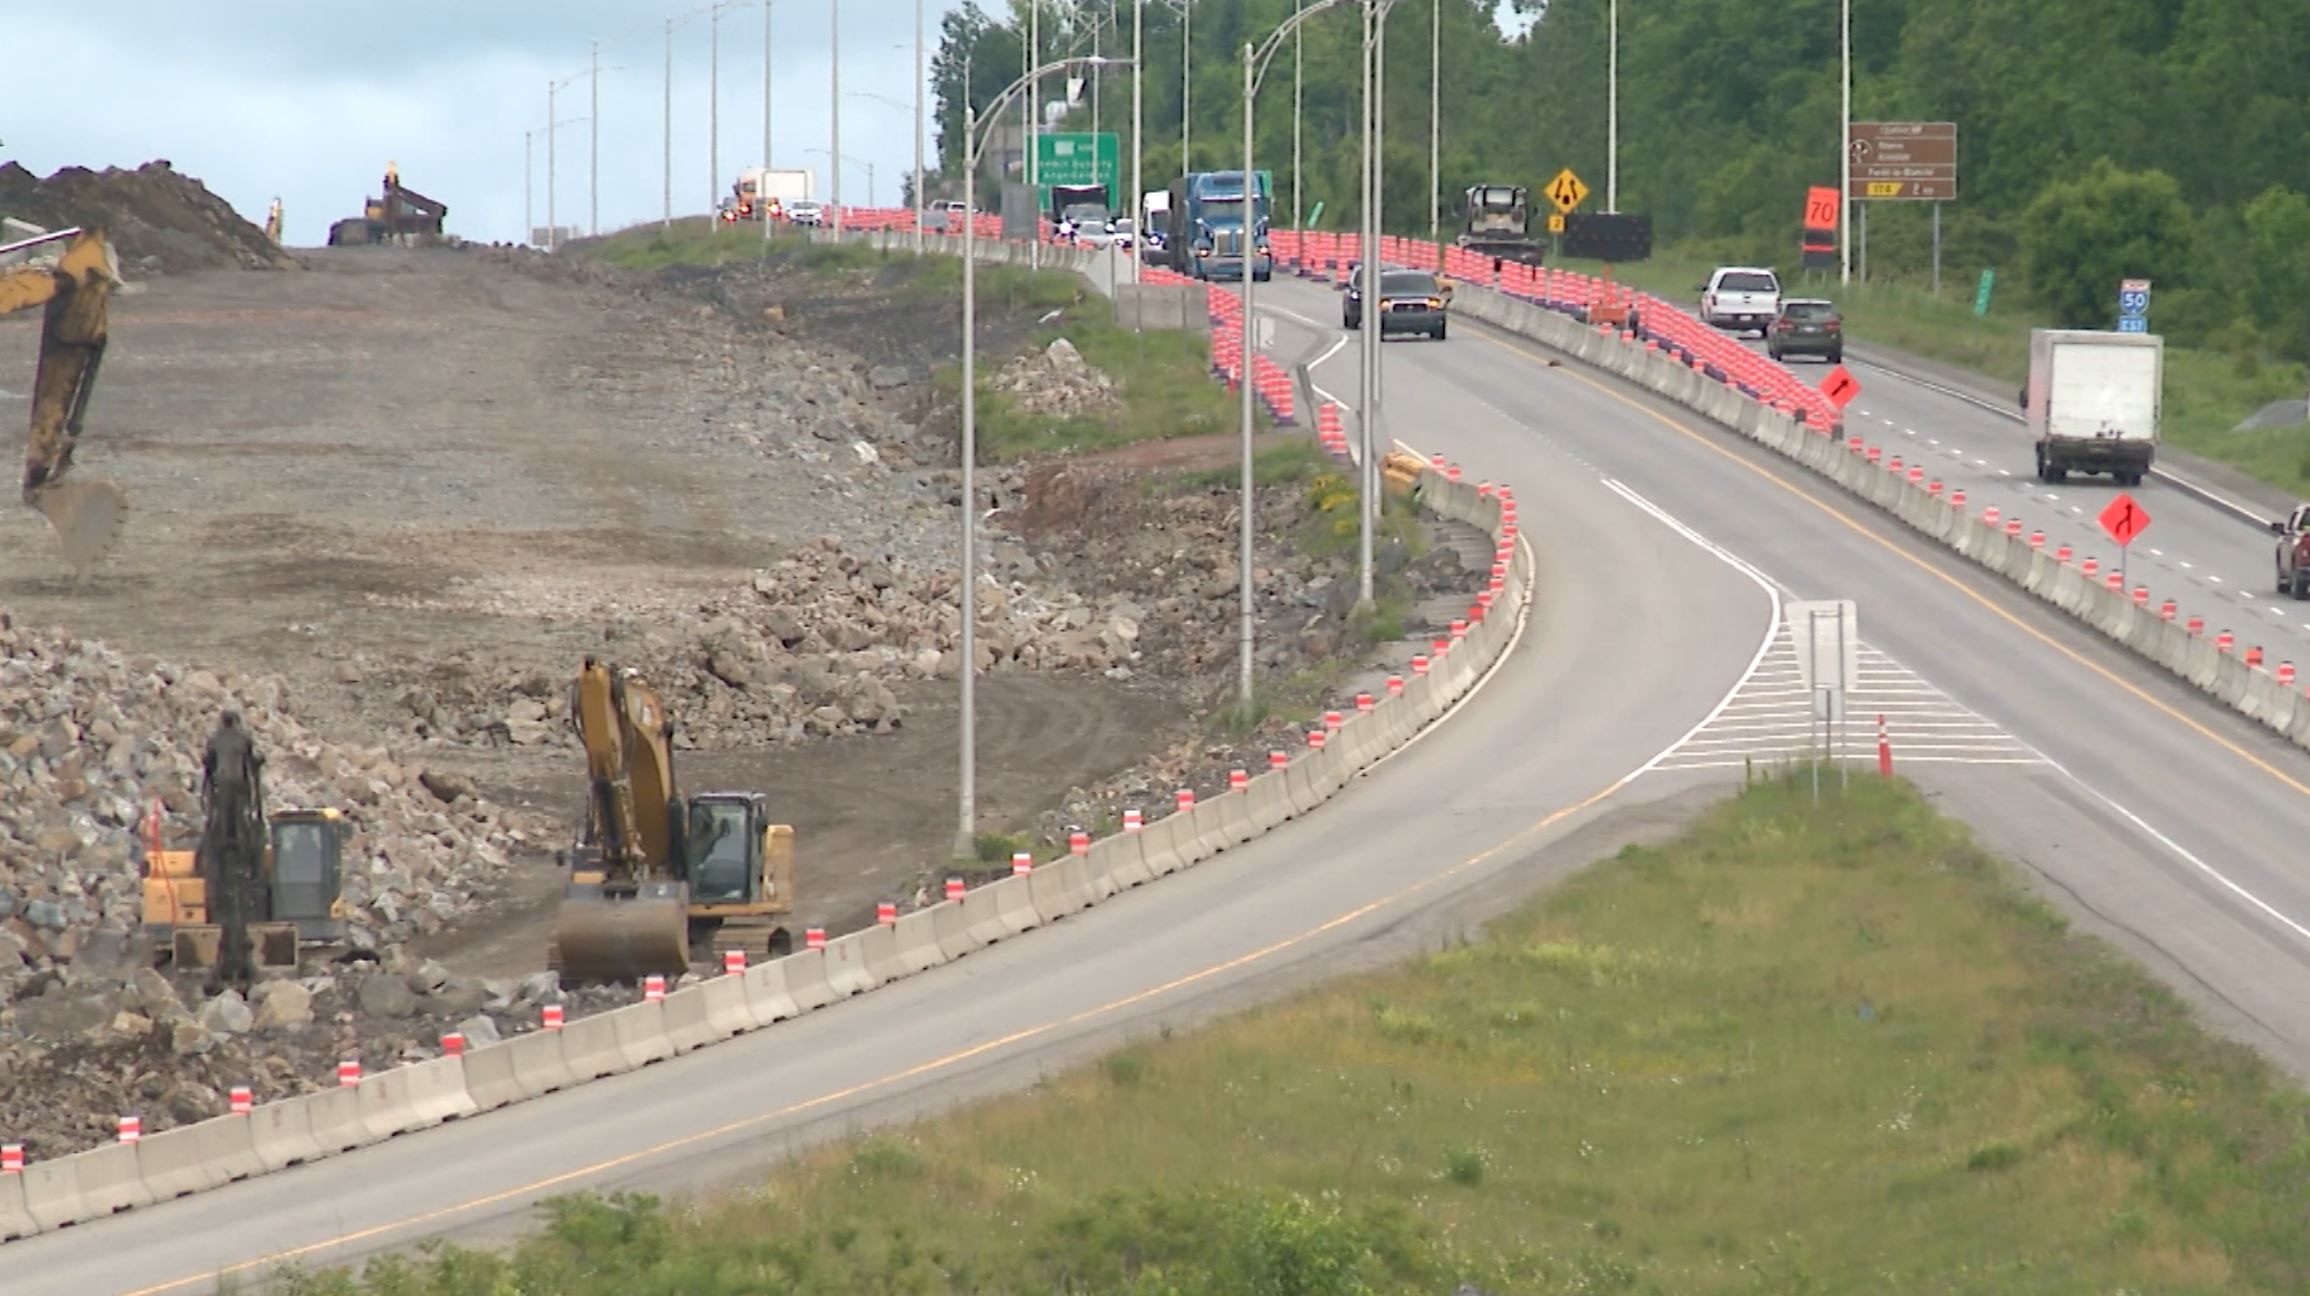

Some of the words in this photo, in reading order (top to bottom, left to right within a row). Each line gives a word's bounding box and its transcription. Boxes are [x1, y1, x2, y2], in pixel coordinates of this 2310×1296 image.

[1810, 201, 1834, 223] 70
[2124, 293, 2146, 307] 50
[2122, 320, 2142, 331] EST
